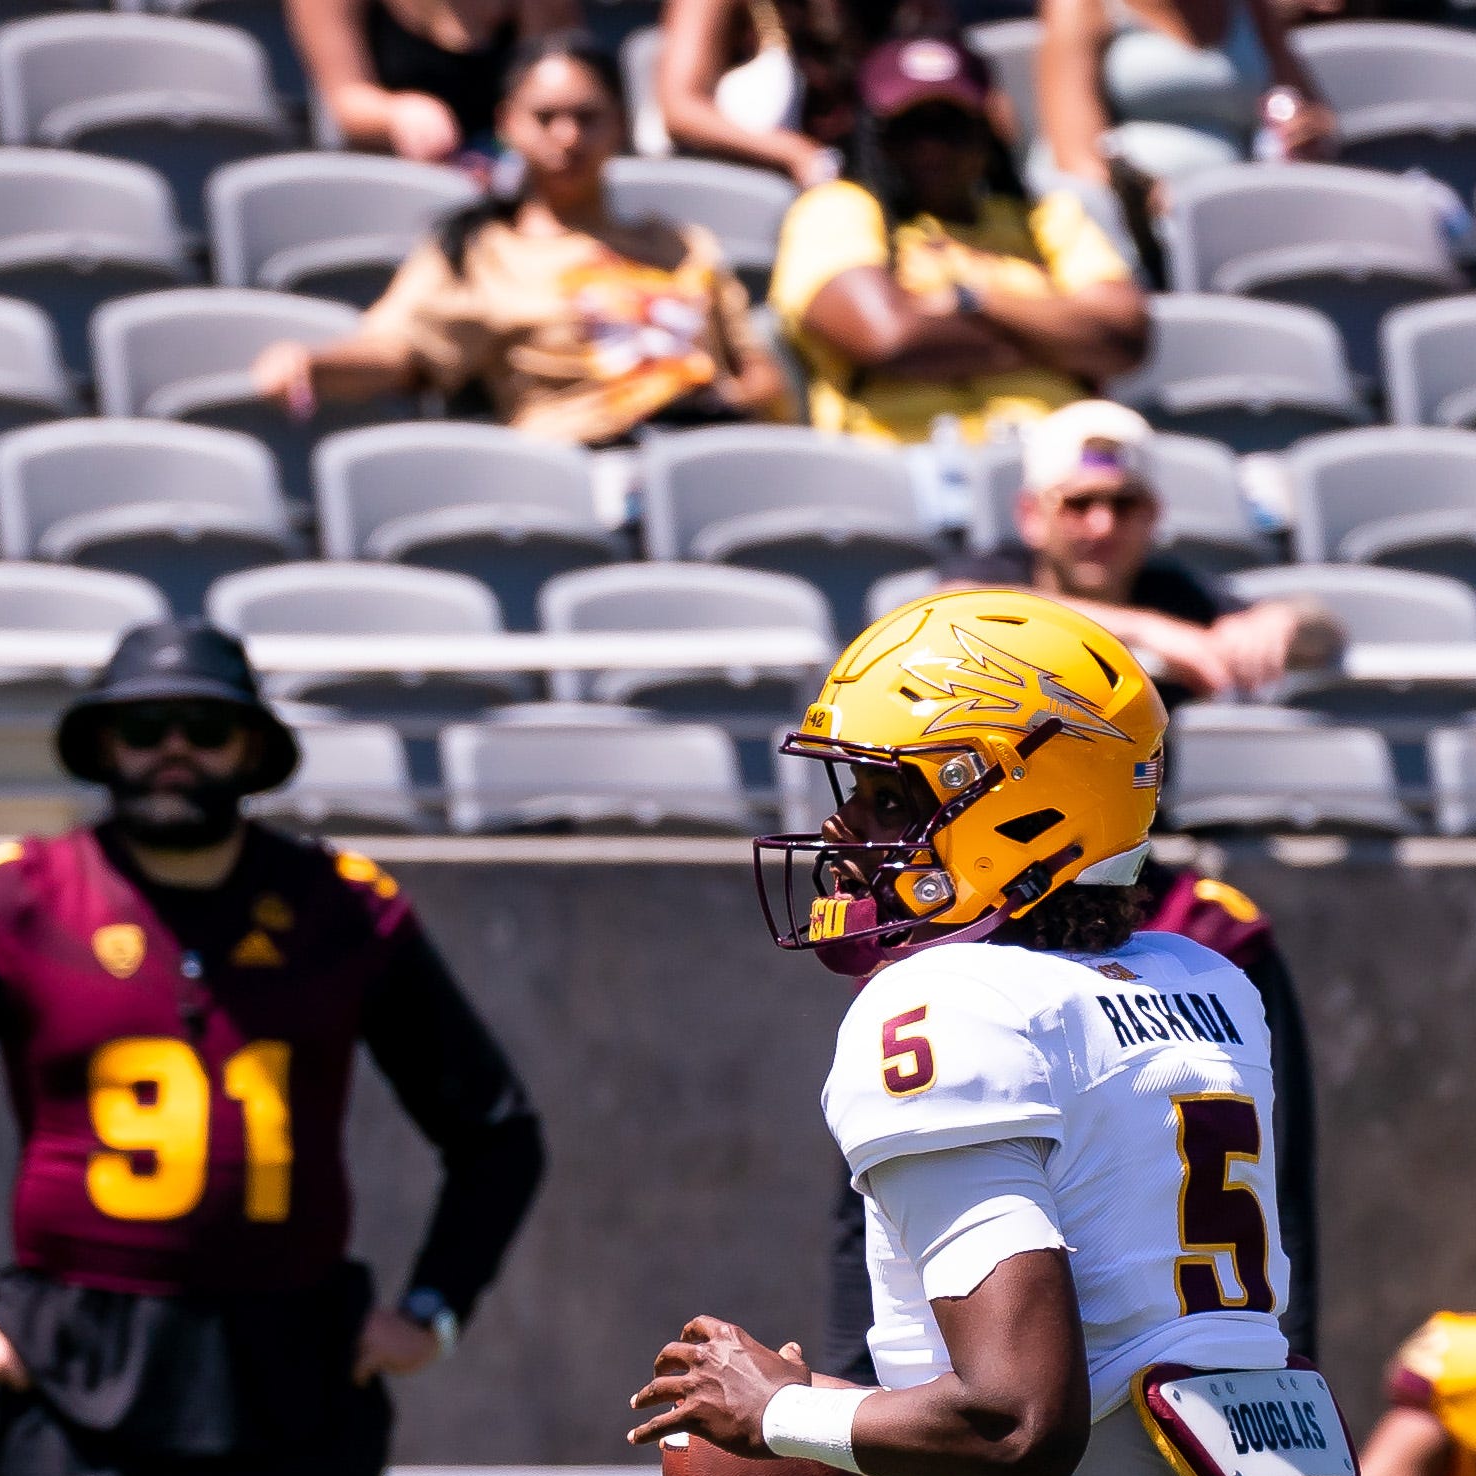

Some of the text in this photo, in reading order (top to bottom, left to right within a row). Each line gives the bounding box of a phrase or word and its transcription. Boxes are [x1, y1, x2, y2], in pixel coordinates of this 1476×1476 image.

[881, 1003, 937, 1098] 5
[1095, 992, 1245, 1049] RASHADA
[86, 1035, 294, 1221] 91
[1169, 1092, 1277, 1317] 5
[1223, 1400, 1327, 1455] DOUGLAS
